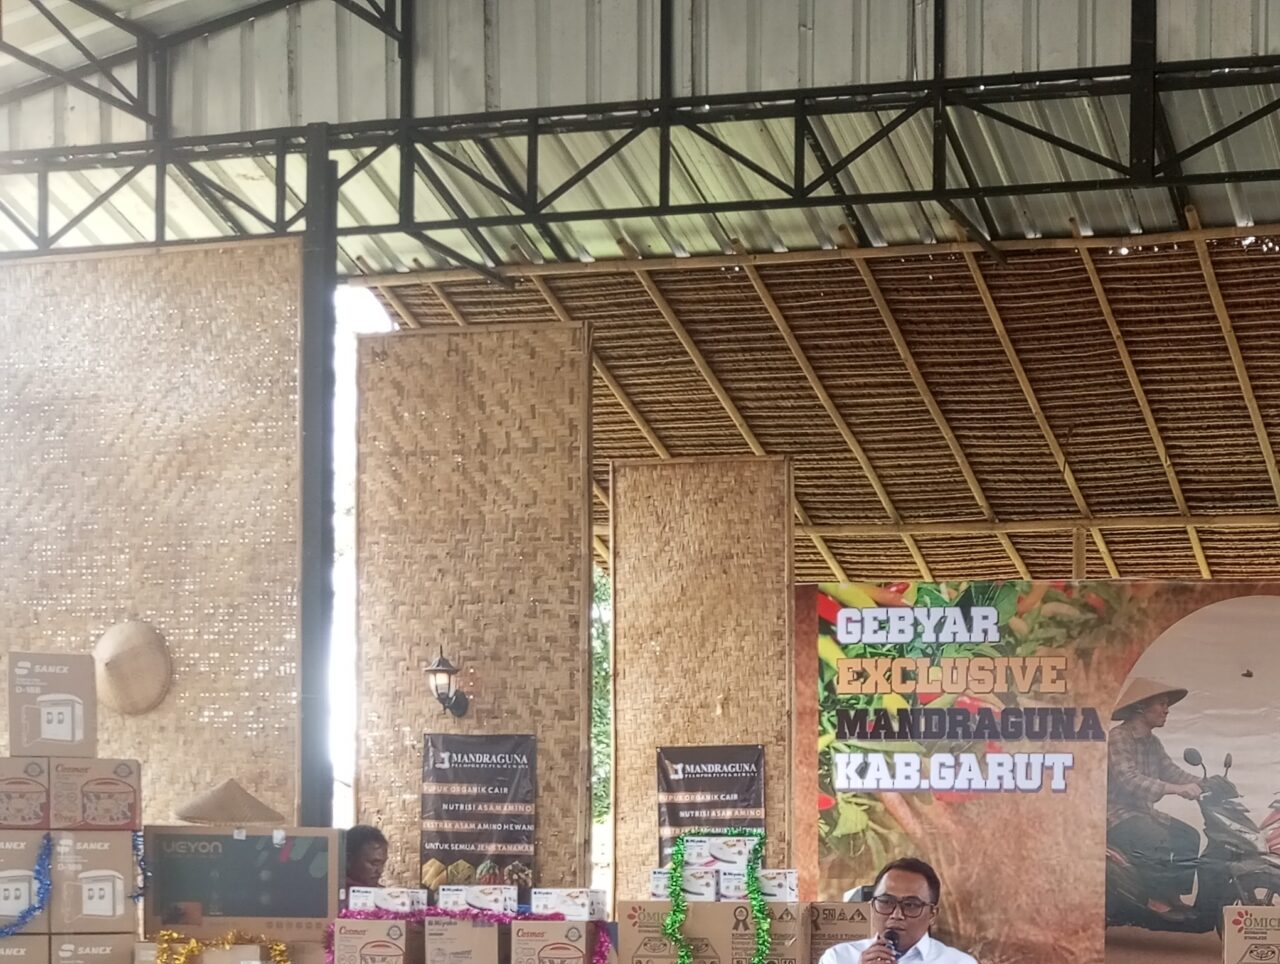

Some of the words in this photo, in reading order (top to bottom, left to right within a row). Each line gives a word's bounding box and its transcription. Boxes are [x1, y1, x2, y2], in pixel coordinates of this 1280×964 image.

[837, 606, 1000, 644] GEBYAR
[34, 664, 69, 674] SANEX
[837, 656, 1068, 694] EXCLUSIVE
[835, 707, 1106, 742] MANDRAGUNA
[451, 753, 528, 764] MANDRAGUNA
[685, 763, 757, 773] MANDRAGUNA
[834, 753, 1073, 793] KAB.GARUT
[451, 784, 486, 793] ORGANIK
[488, 786, 508, 794] CAIR
[685, 793, 719, 801] ORGANIK
[720, 793, 738, 801] CAIR
[442, 803, 476, 811] NUTRISI
[477, 803, 502, 812] ASAM
[503, 804, 531, 812] AMINO
[679, 810, 710, 818] NUTRISI
[477, 823, 502, 831] AMINO
[75, 841, 111, 850] SANEX
[425, 842, 449, 850] UNTUK
[450, 843, 476, 851] SEMUA
[339, 926, 368, 936] Cosmos
[516, 928, 548, 938] Cosmos
[76, 946, 112, 955] SANEX
